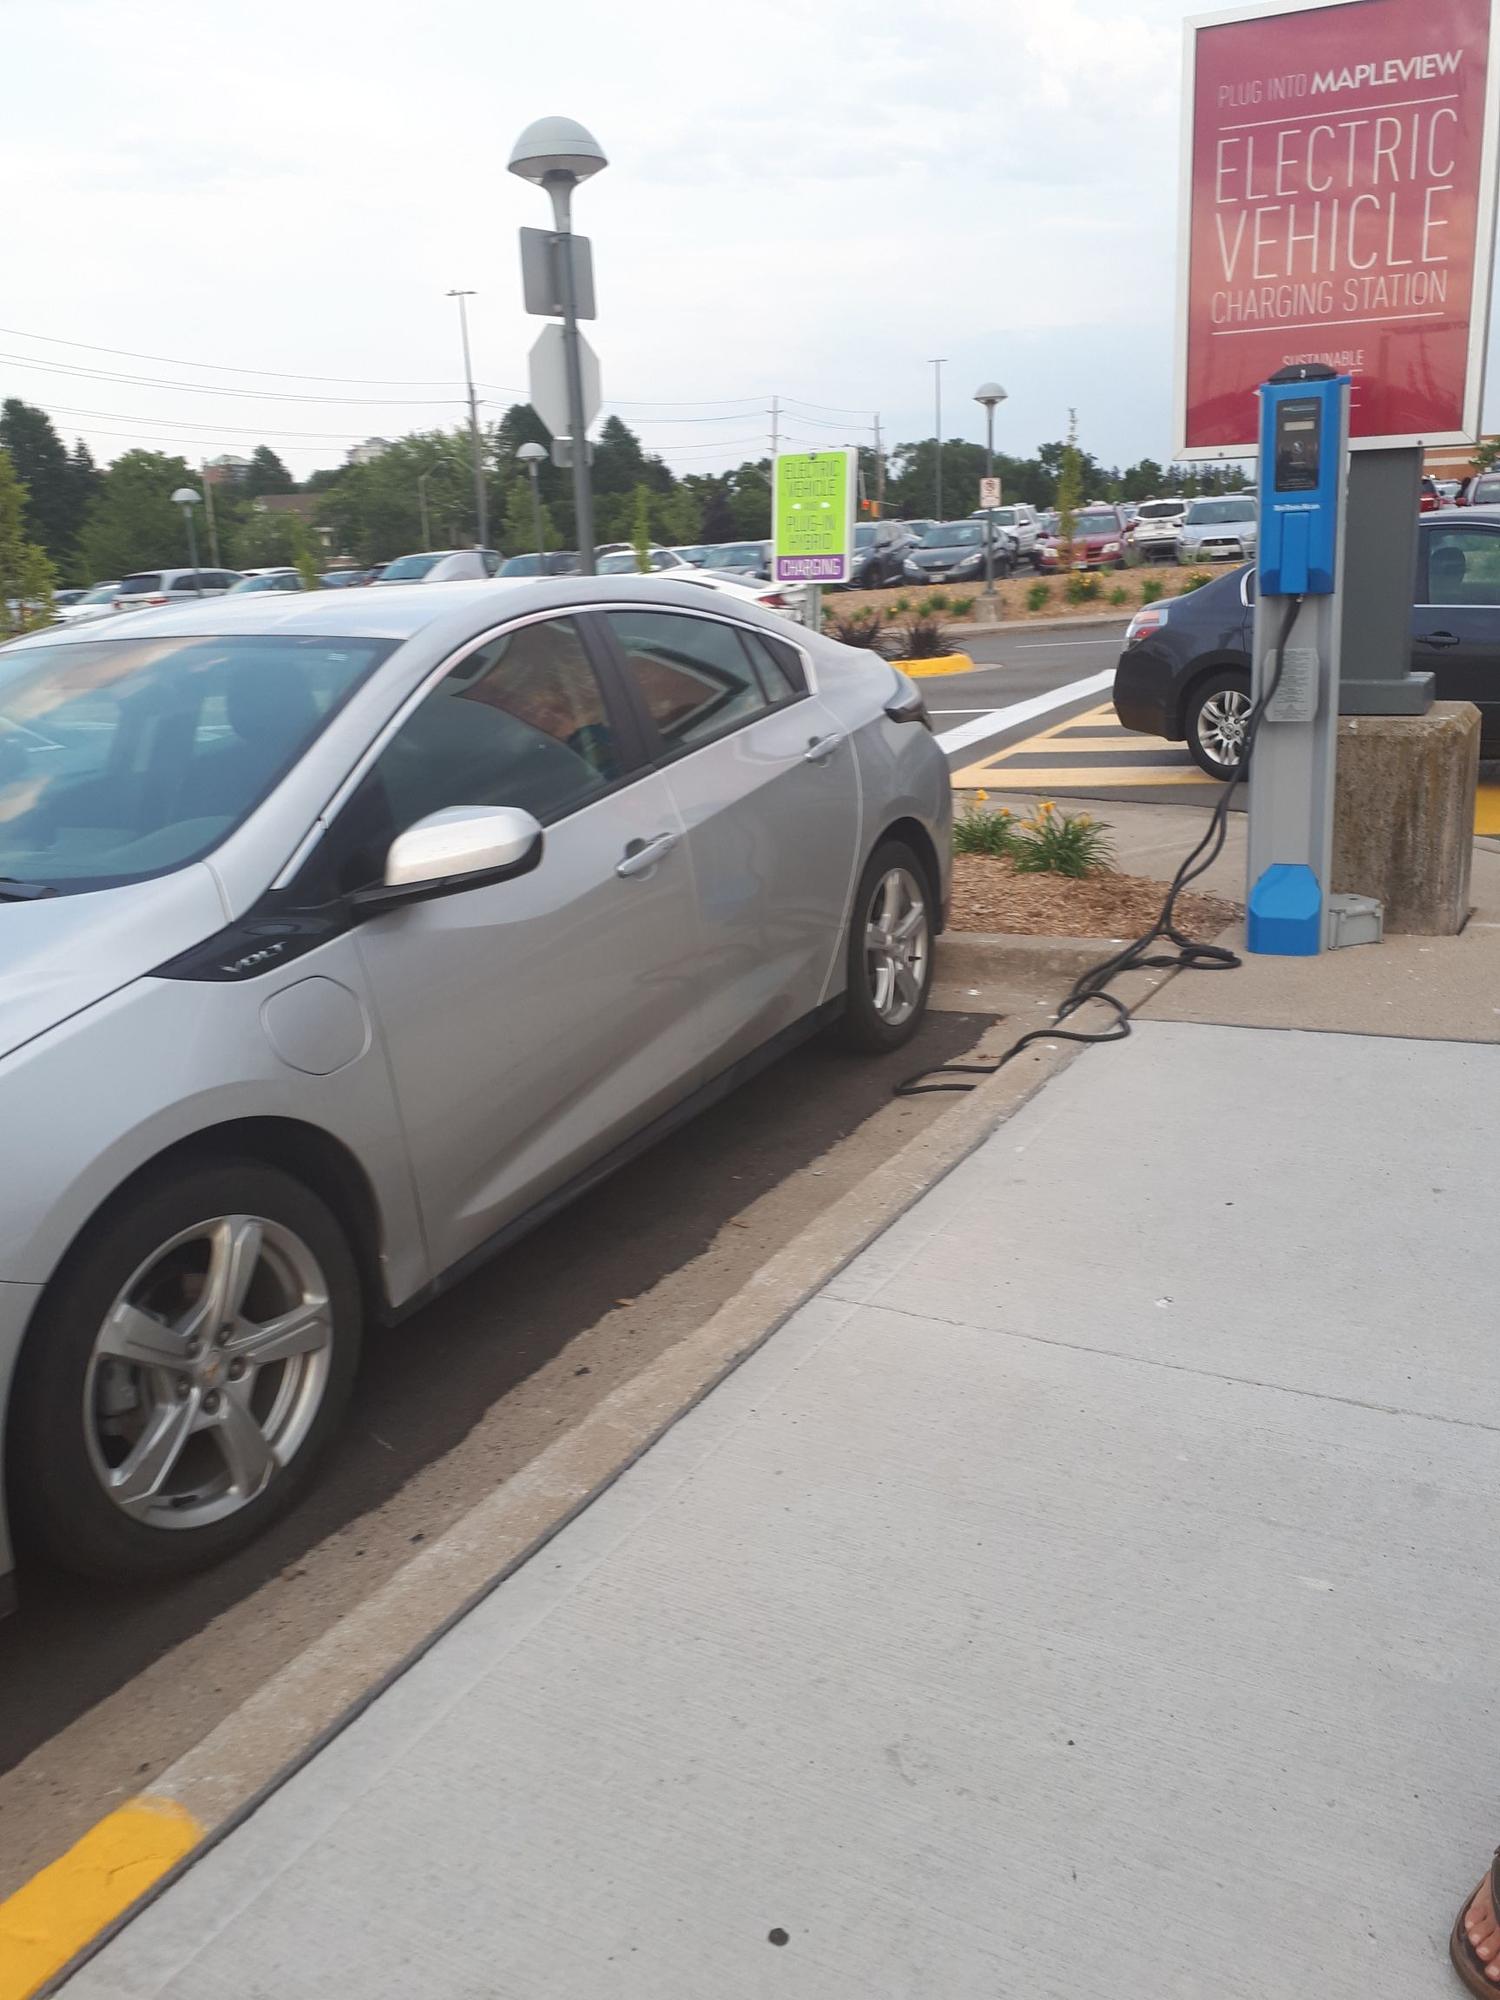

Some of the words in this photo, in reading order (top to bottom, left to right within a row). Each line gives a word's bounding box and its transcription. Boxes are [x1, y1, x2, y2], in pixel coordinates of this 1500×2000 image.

[1218, 80, 1262, 108] PLUG
[1267, 73, 1307, 101] INTO
[1310, 49, 1463, 94] MAPLEVIEW
[1216, 108, 1458, 204] ELECTRIC
[1216, 185, 1454, 283] VEHICLE
[1211, 280, 1333, 324] CHARGING
[1343, 269, 1448, 312] STATION
[780, 558, 841, 577] CHARGING
[219, 941, 287, 973] VOLT
